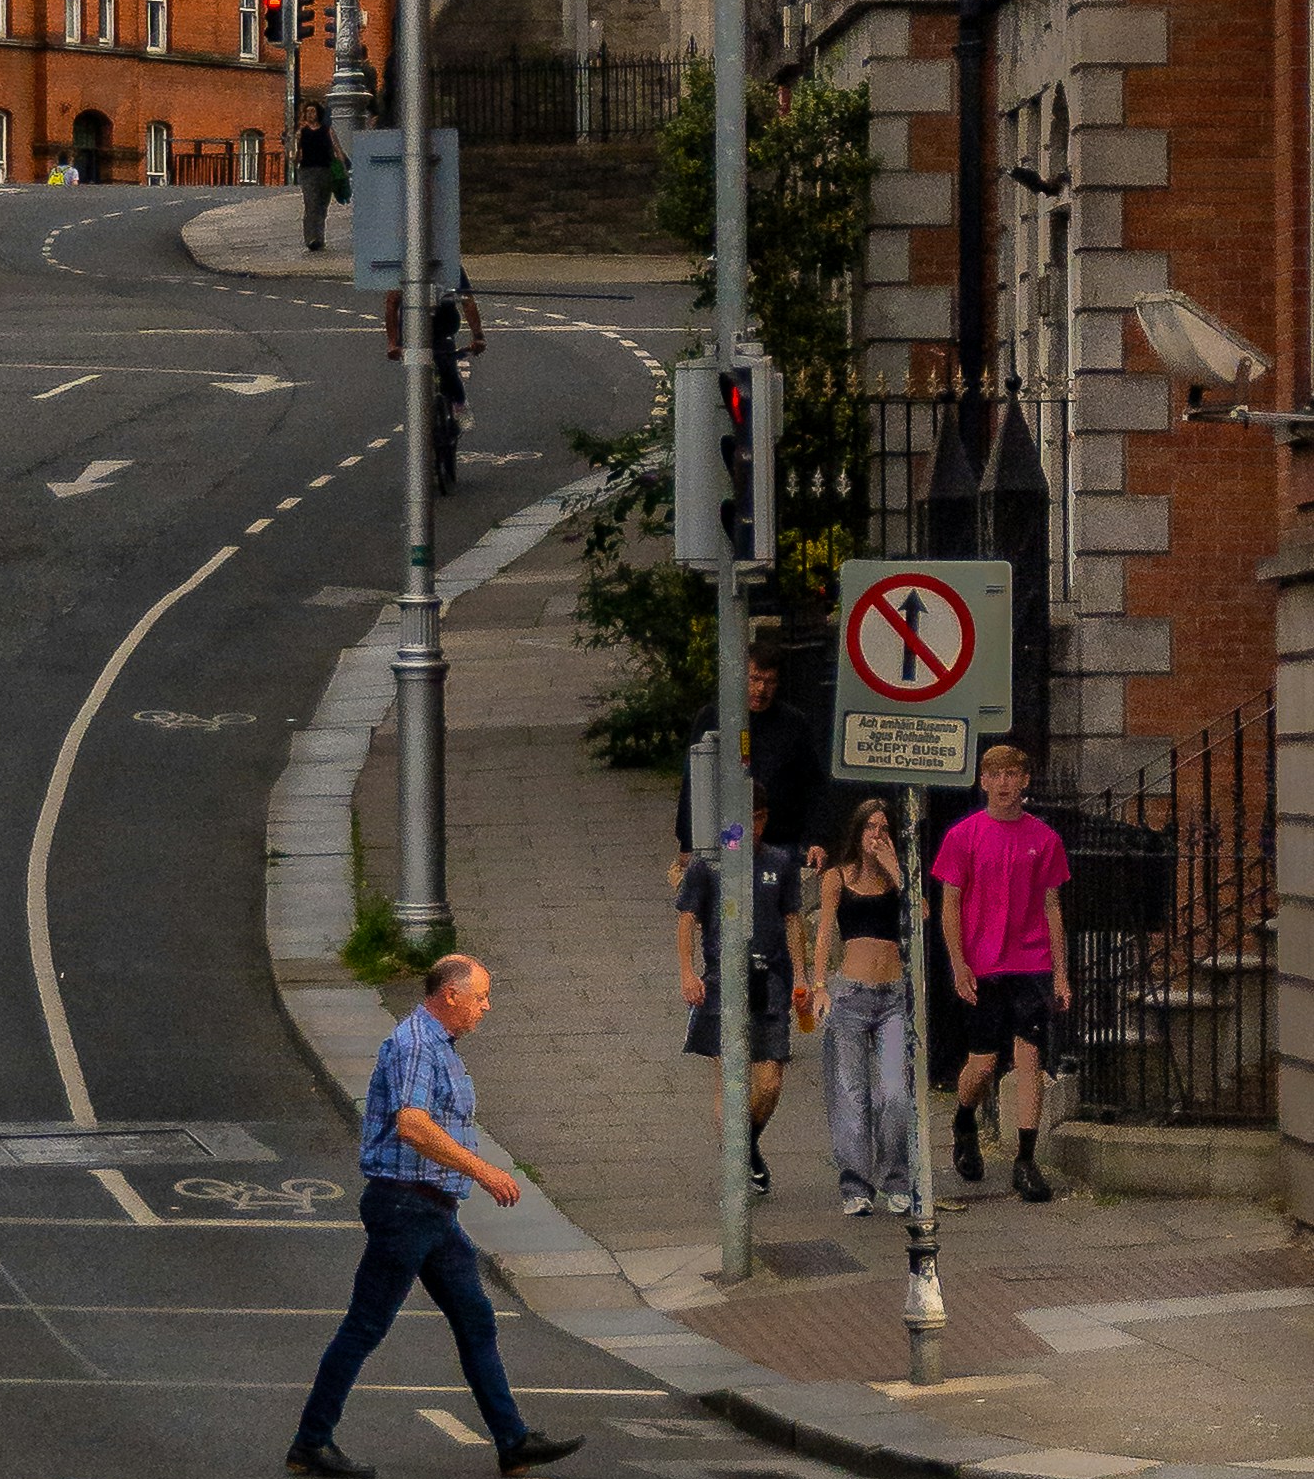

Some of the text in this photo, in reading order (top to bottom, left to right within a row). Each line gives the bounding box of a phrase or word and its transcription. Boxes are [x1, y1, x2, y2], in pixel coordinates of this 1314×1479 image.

[859, 715, 878, 728] Ach
[869, 730, 893, 743] agus
[857, 741, 957, 757] EXCEPT BUSES
[867, 754, 945, 768] and Cyclists
